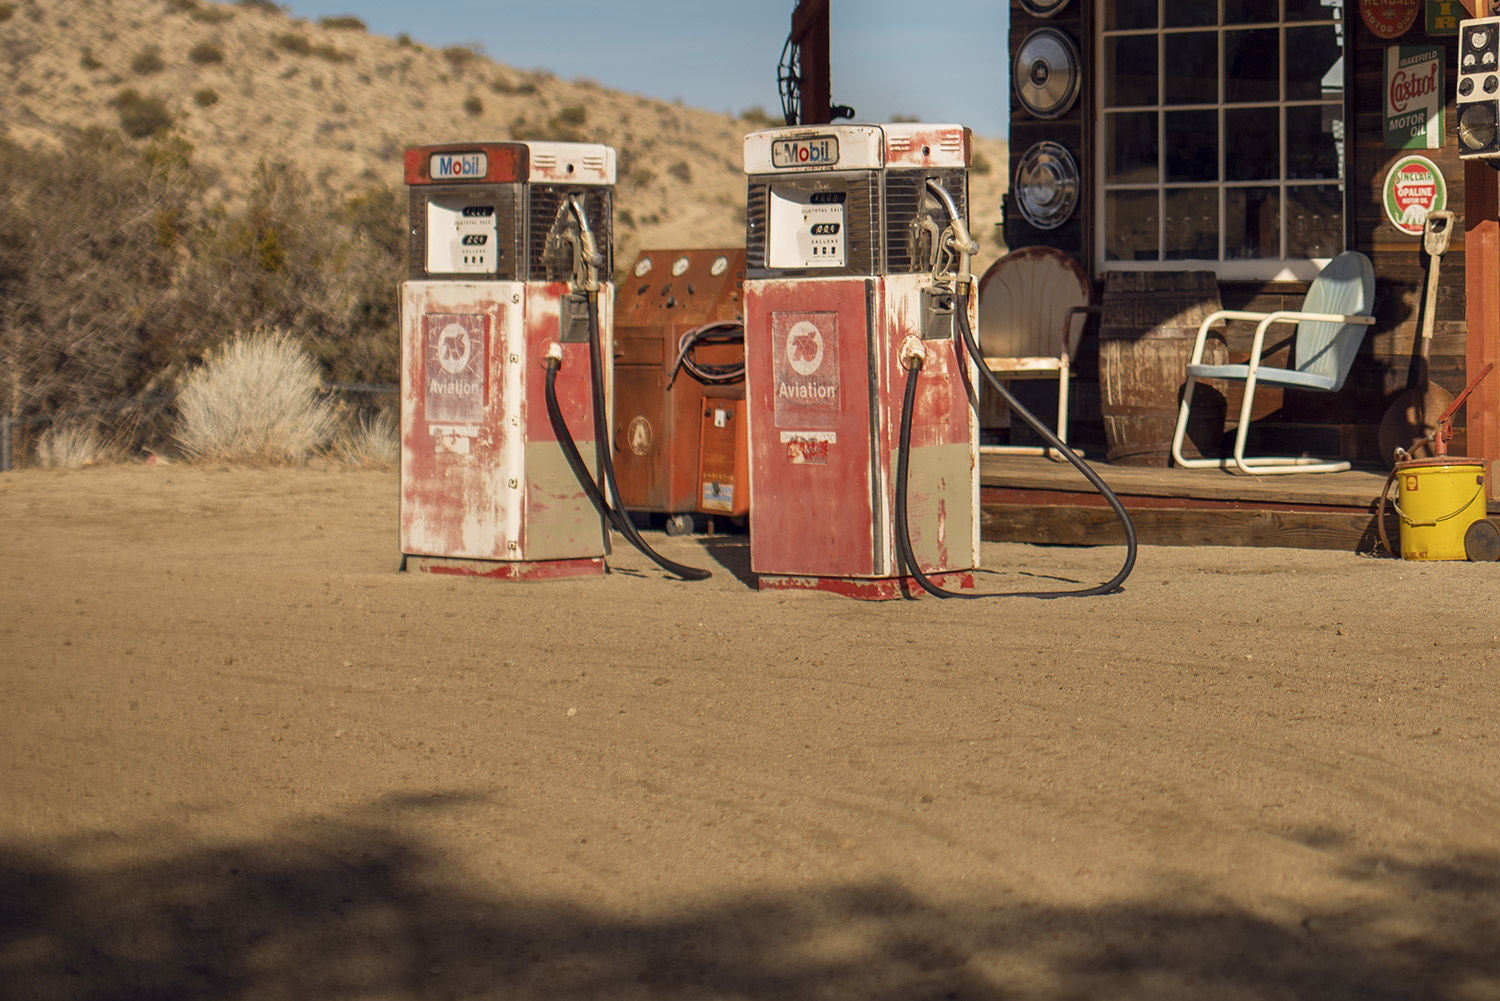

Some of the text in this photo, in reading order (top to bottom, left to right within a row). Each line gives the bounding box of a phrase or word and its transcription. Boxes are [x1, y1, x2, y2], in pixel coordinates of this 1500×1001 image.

[1365, 8, 1394, 33] MOTOR
[1400, 50, 1438, 68] WAKEFIELD
[1390, 63, 1437, 112] Castrol
[1389, 112, 1425, 132] MOTOR
[1410, 124, 1426, 137] OIL
[784, 141, 829, 162] Mobil
[440, 156, 479, 175] Mobil
[1395, 170, 1432, 184] SINCLAIR
[1398, 186, 1432, 196] OPALINE
[429, 379, 479, 395] Aviation
[779, 380, 836, 399] Aviation
